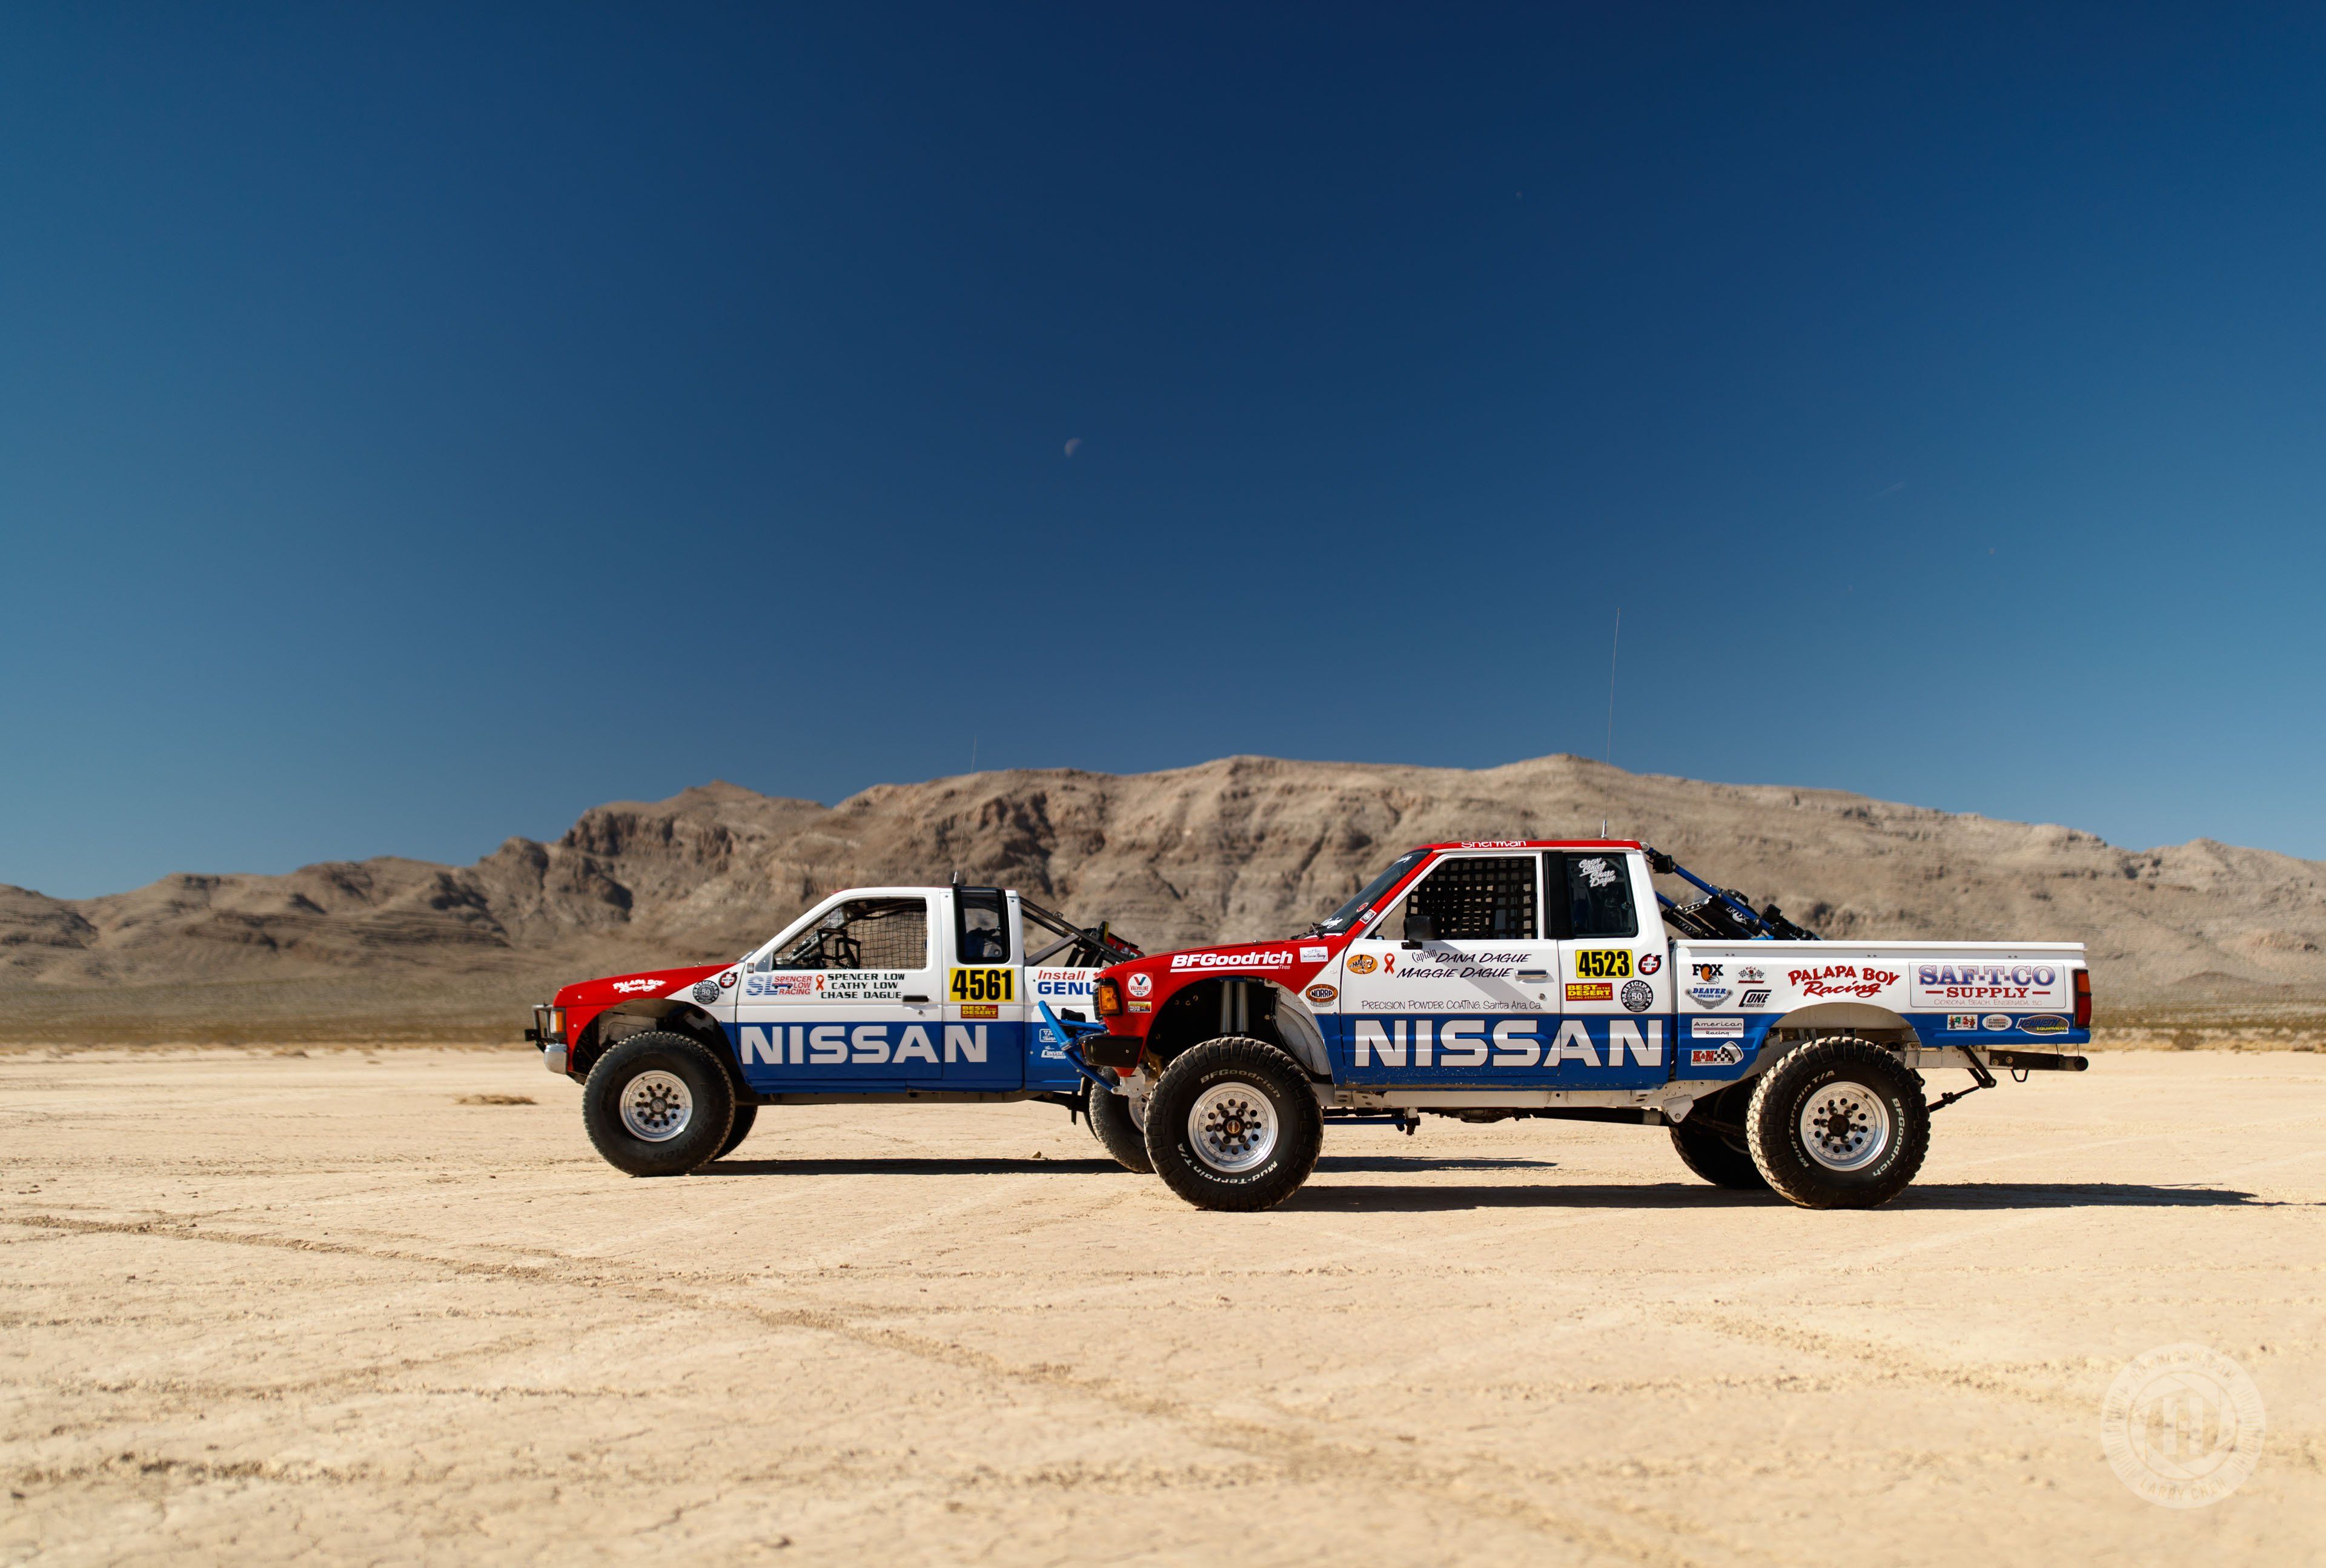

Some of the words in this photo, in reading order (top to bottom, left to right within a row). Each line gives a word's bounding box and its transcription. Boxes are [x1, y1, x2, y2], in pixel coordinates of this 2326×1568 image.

[1579, 857, 1602, 868] Crew
[1589, 870, 1615, 879] Chase
[1589, 875, 1616, 887] Dague
[1171, 951, 1293, 968] BFGoodrich
[1411, 948, 1437, 964] Captain
[1435, 953, 1476, 963] DANA
[1479, 953, 1532, 963] DAGUE
[1579, 950, 1630, 977] 4523
[1692, 964, 1724, 977] FOX
[1038, 970, 1086, 981] Install
[1396, 967, 1459, 979] MAGGIE
[1459, 967, 1514, 978] DAGUE
[1788, 965, 1857, 987] PALAPA
[1862, 967, 1901, 985] BOY
[612, 979, 646, 990] PALAPA
[952, 970, 1012, 1001] 4561
[1803, 981, 1882, 998] Racing
[1311, 989, 1333, 997] NORRA
[1622, 981, 1652, 1004] PARTICIPANT
[1946, 987, 2029, 998] SUPPLY
[1362, 1000, 1405, 1010] PRECISION
[1408, 1000, 1444, 1010] POWDER
[1483, 1001, 1509, 1010] Santa
[2017, 1018, 2061, 1027] KENNEDY
[740, 1025, 987, 1065] NISSAN
[1354, 1019, 1663, 1067] NISSAN
[1041, 1050, 1065, 1058] CONVER
[1692, 1050, 1715, 1062] K&N
[1200, 1069, 1281, 1098] BFGoodrich
[1872, 1097, 1905, 1177] BFGoodrich
[1178, 1143, 1192, 1166] T/A
[1193, 1160, 1278, 1184] Mud-Terrain
